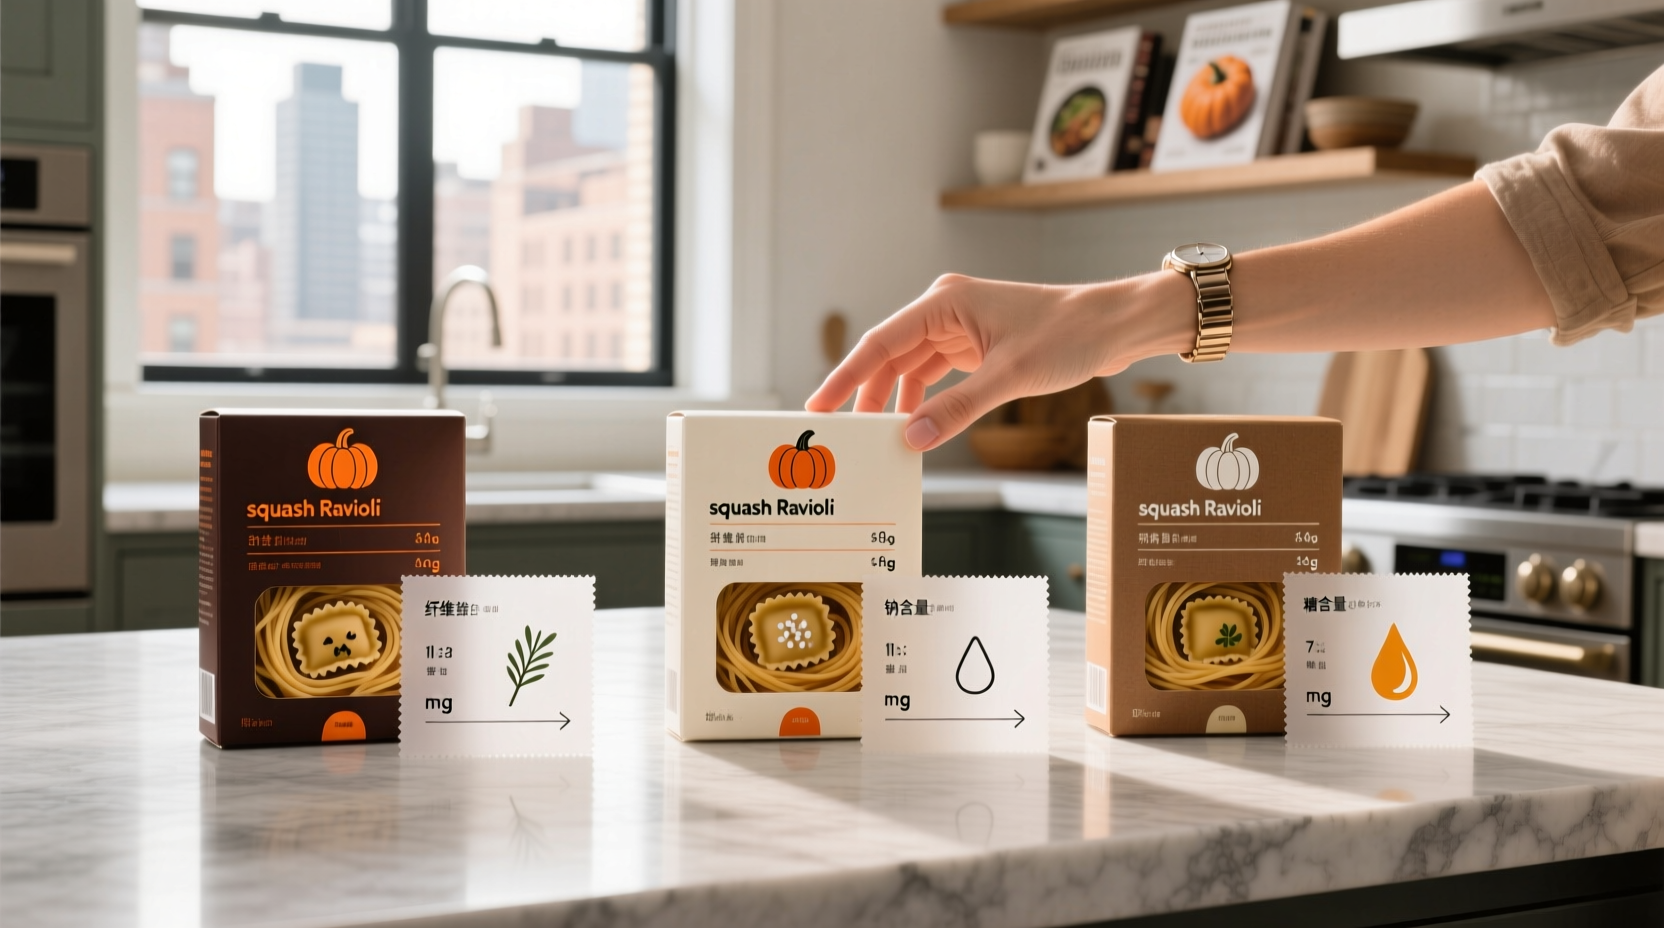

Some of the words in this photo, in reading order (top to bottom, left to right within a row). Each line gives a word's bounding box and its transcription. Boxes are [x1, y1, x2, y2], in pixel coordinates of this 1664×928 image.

[246, 500, 315, 522] squash
[320, 498, 381, 517] Ravioli
[709, 499, 772, 520] squash
[777, 498, 835, 516] Ravioli
[1138, 499, 1201, 521] squash
[1204, 499, 1262, 517] Ravioli
[425, 697, 453, 714] mg
[884, 694, 911, 711] mg
[1306, 690, 1332, 708] mg
